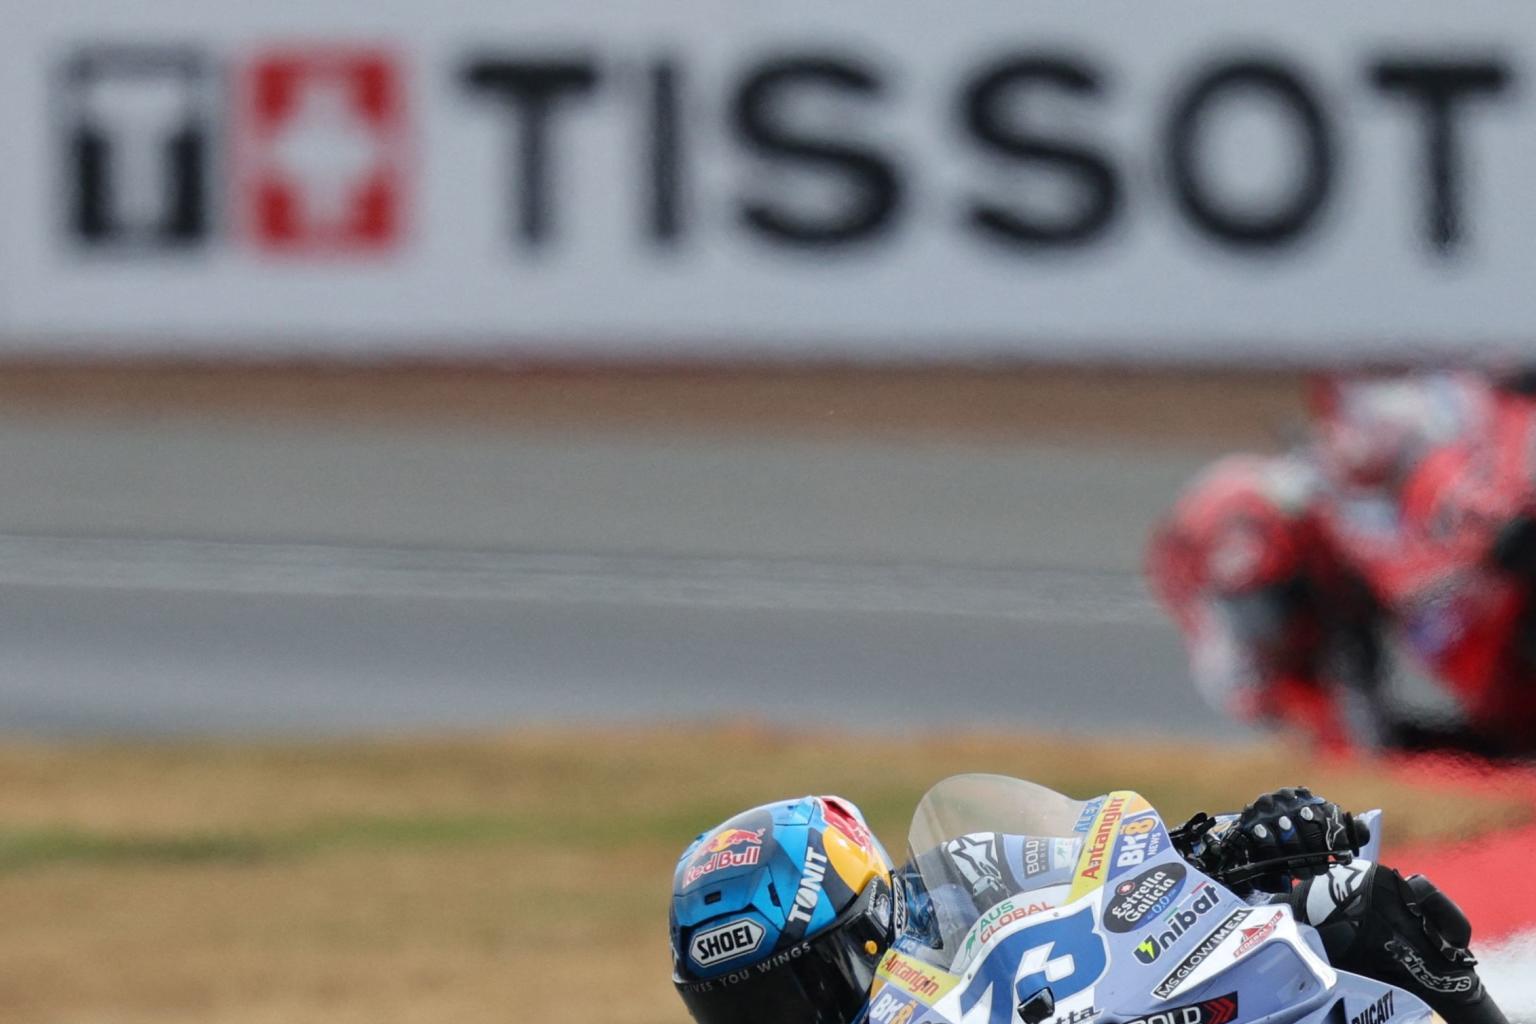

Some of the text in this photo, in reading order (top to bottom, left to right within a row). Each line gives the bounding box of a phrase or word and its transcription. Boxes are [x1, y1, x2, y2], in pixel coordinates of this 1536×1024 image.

[460, 50, 1515, 254] TISSOT
[716, 845, 761, 871] Bull
[1025, 839, 1040, 875] BOLD
[1117, 813, 1157, 869] BK8
[978, 901, 1016, 928] AUS
[1112, 869, 1167, 920] Estrella
[1124, 876, 1176, 923] Galicia
[696, 925, 754, 961] SHOEI
[979, 901, 1056, 946] GLOBAL
[1134, 884, 1221, 964] Unibat
[683, 941, 812, 994] IVES YOU WINGS
[883, 951, 940, 998] Antangin
[1157, 909, 1249, 999] MS GLOW MEN
